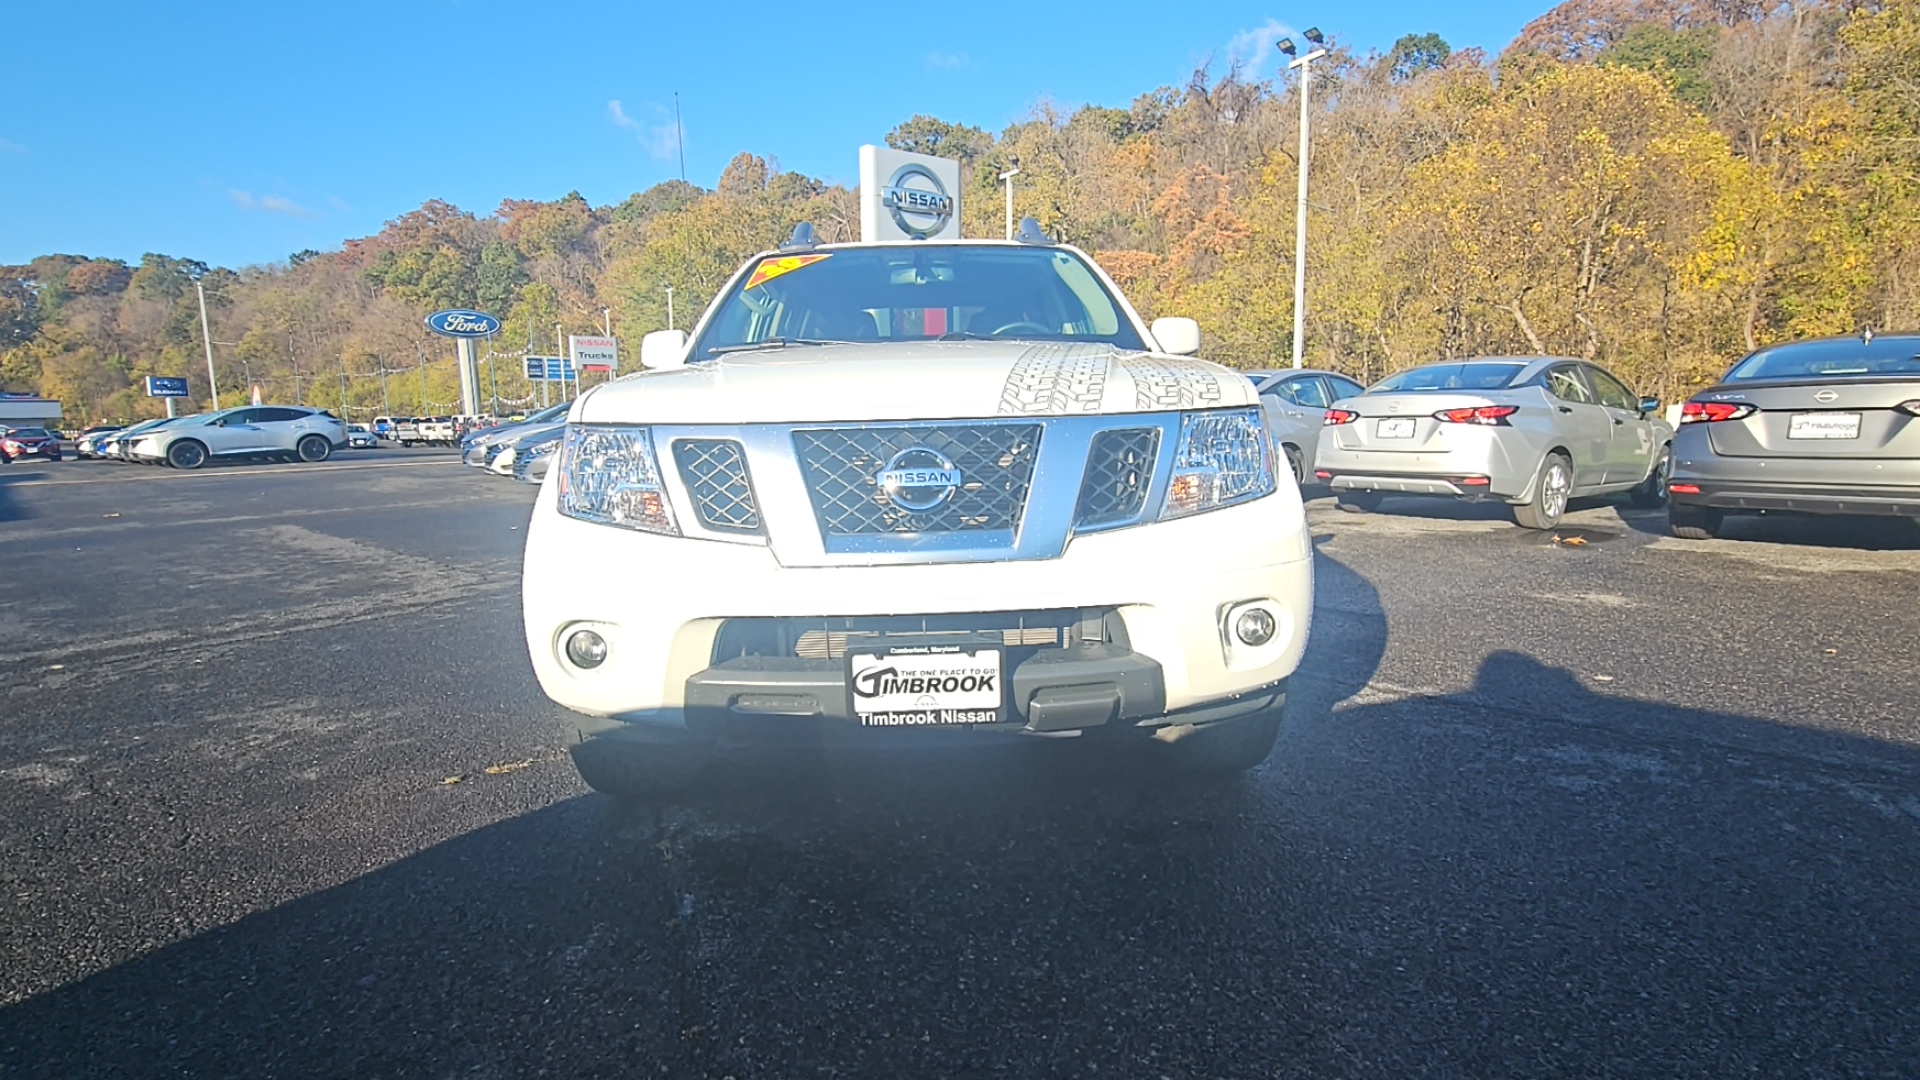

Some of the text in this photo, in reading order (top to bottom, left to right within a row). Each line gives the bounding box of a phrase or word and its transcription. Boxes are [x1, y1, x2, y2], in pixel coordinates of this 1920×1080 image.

[891, 190, 949, 211] NISSAN
[444, 314, 488, 332] Ford
[576, 339, 614, 347] NISSAN
[578, 351, 614, 360] Trucks
[885, 472, 952, 484] NISSAN
[852, 666, 996, 698] TIMBROOK
[859, 709, 996, 726] Timbrook Nissan
